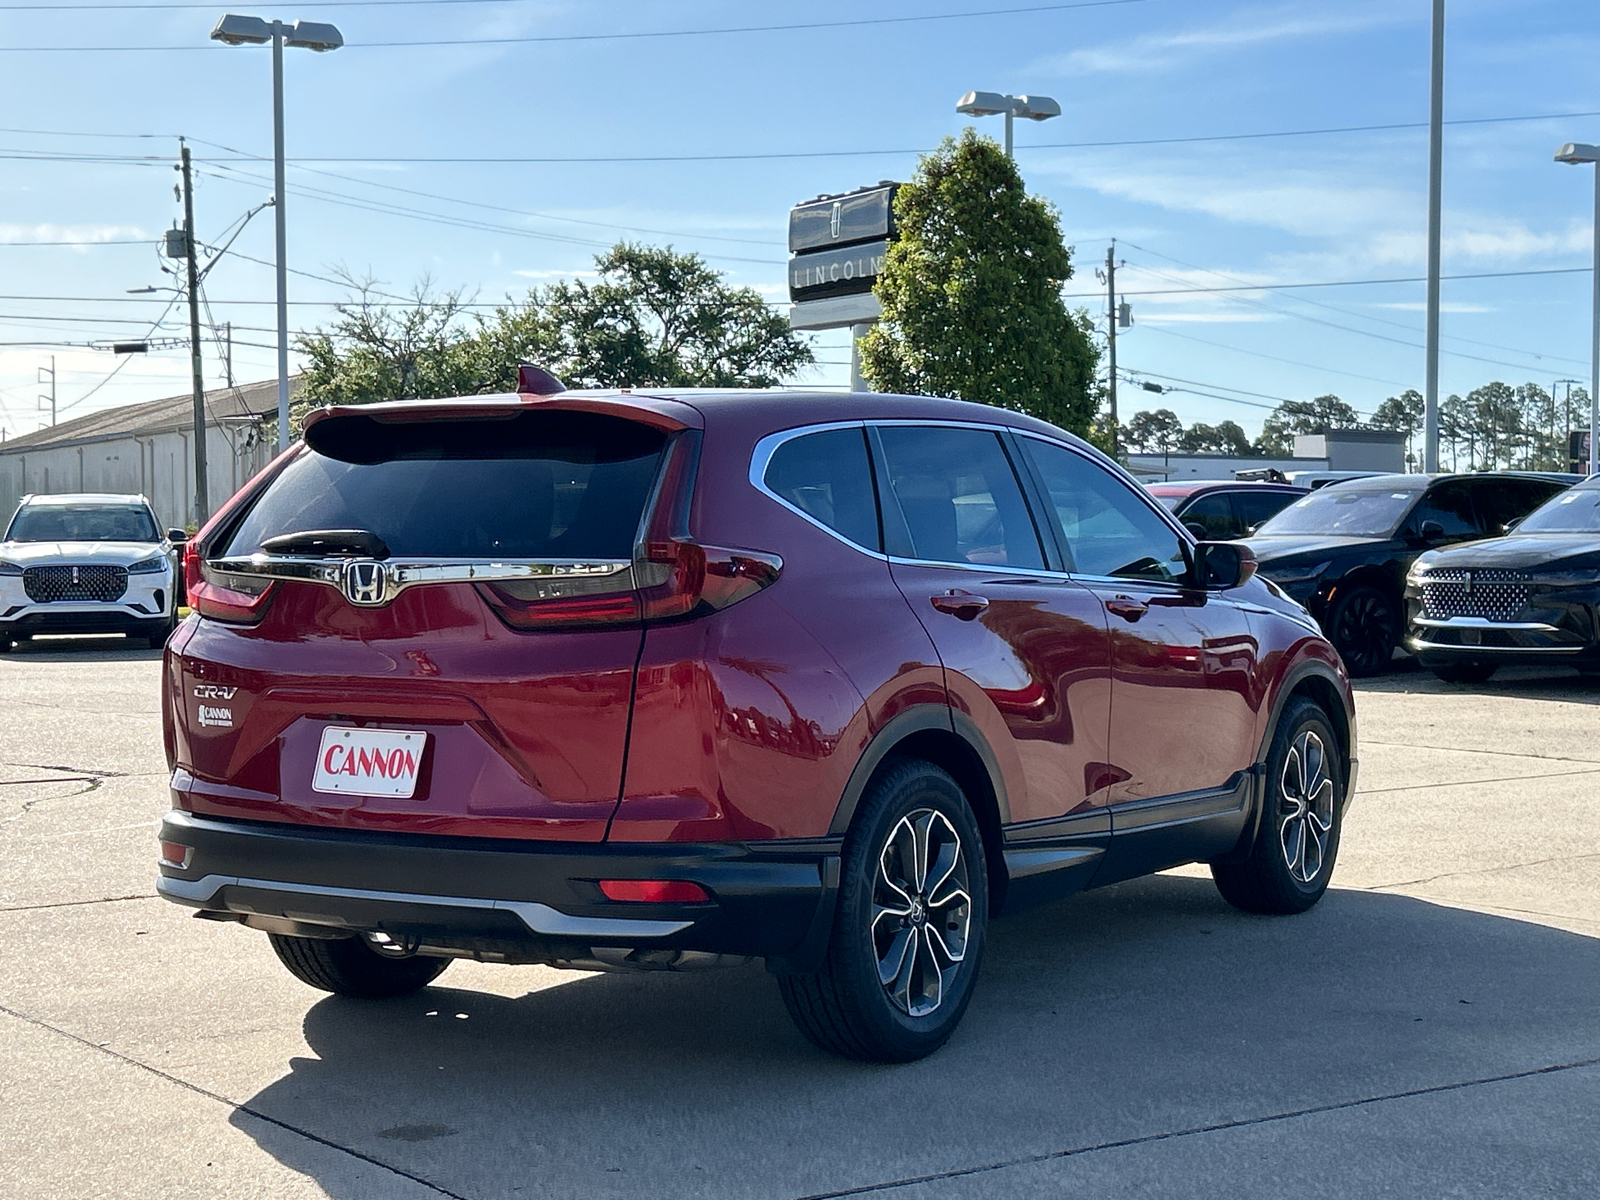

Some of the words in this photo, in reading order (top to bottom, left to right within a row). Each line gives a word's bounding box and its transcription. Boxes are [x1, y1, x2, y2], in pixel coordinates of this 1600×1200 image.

[794, 256, 884, 289] LINCOLN
[193, 684, 239, 700] CR-V
[204, 706, 232, 720] CANNON
[323, 744, 420, 780] CANNON
